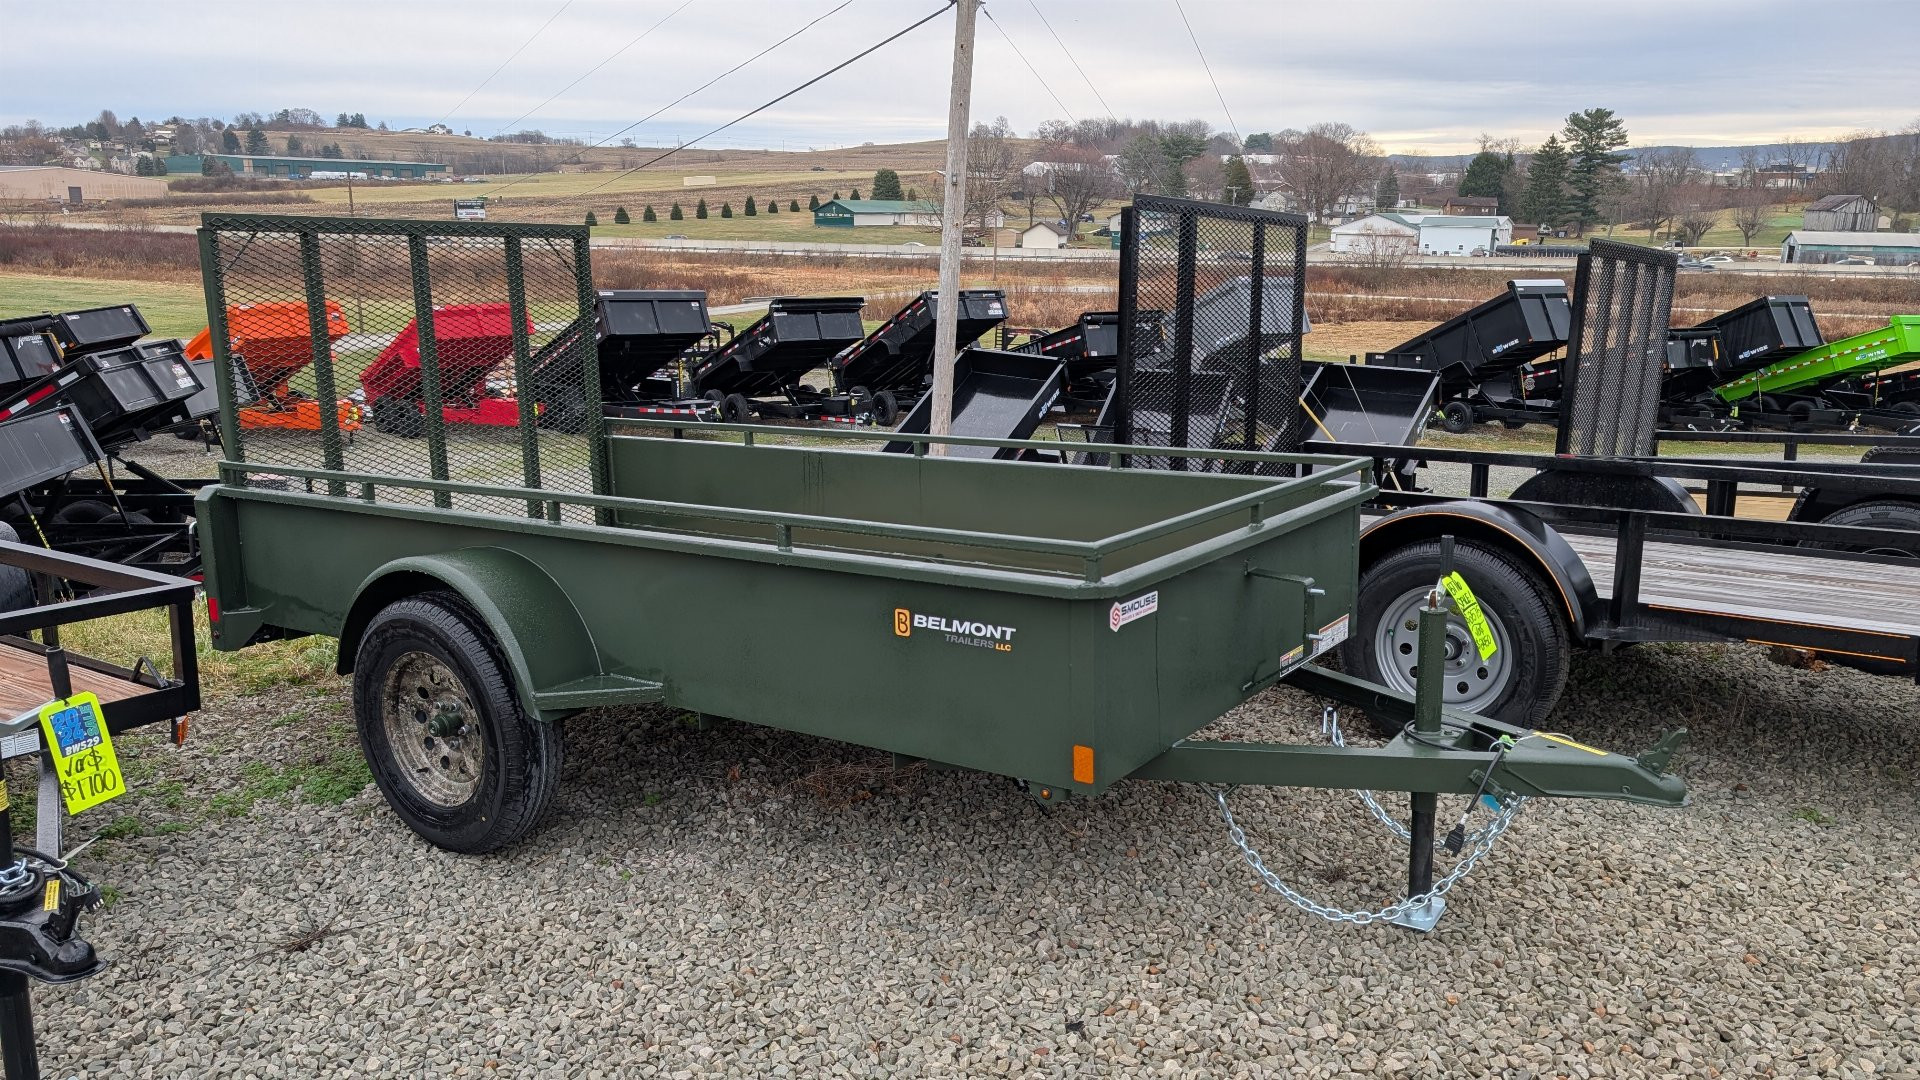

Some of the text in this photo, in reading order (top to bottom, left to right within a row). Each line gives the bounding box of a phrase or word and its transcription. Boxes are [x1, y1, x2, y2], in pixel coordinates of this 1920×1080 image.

[1121, 594, 1157, 616] SMOUSE
[913, 613, 1017, 641] BELMONT
[945, 634, 1012, 652] TRAILERS LLC
[80, 704, 100, 737] SALE
[65, 736, 100, 756] BW529
[61, 768, 117, 801] $1700
